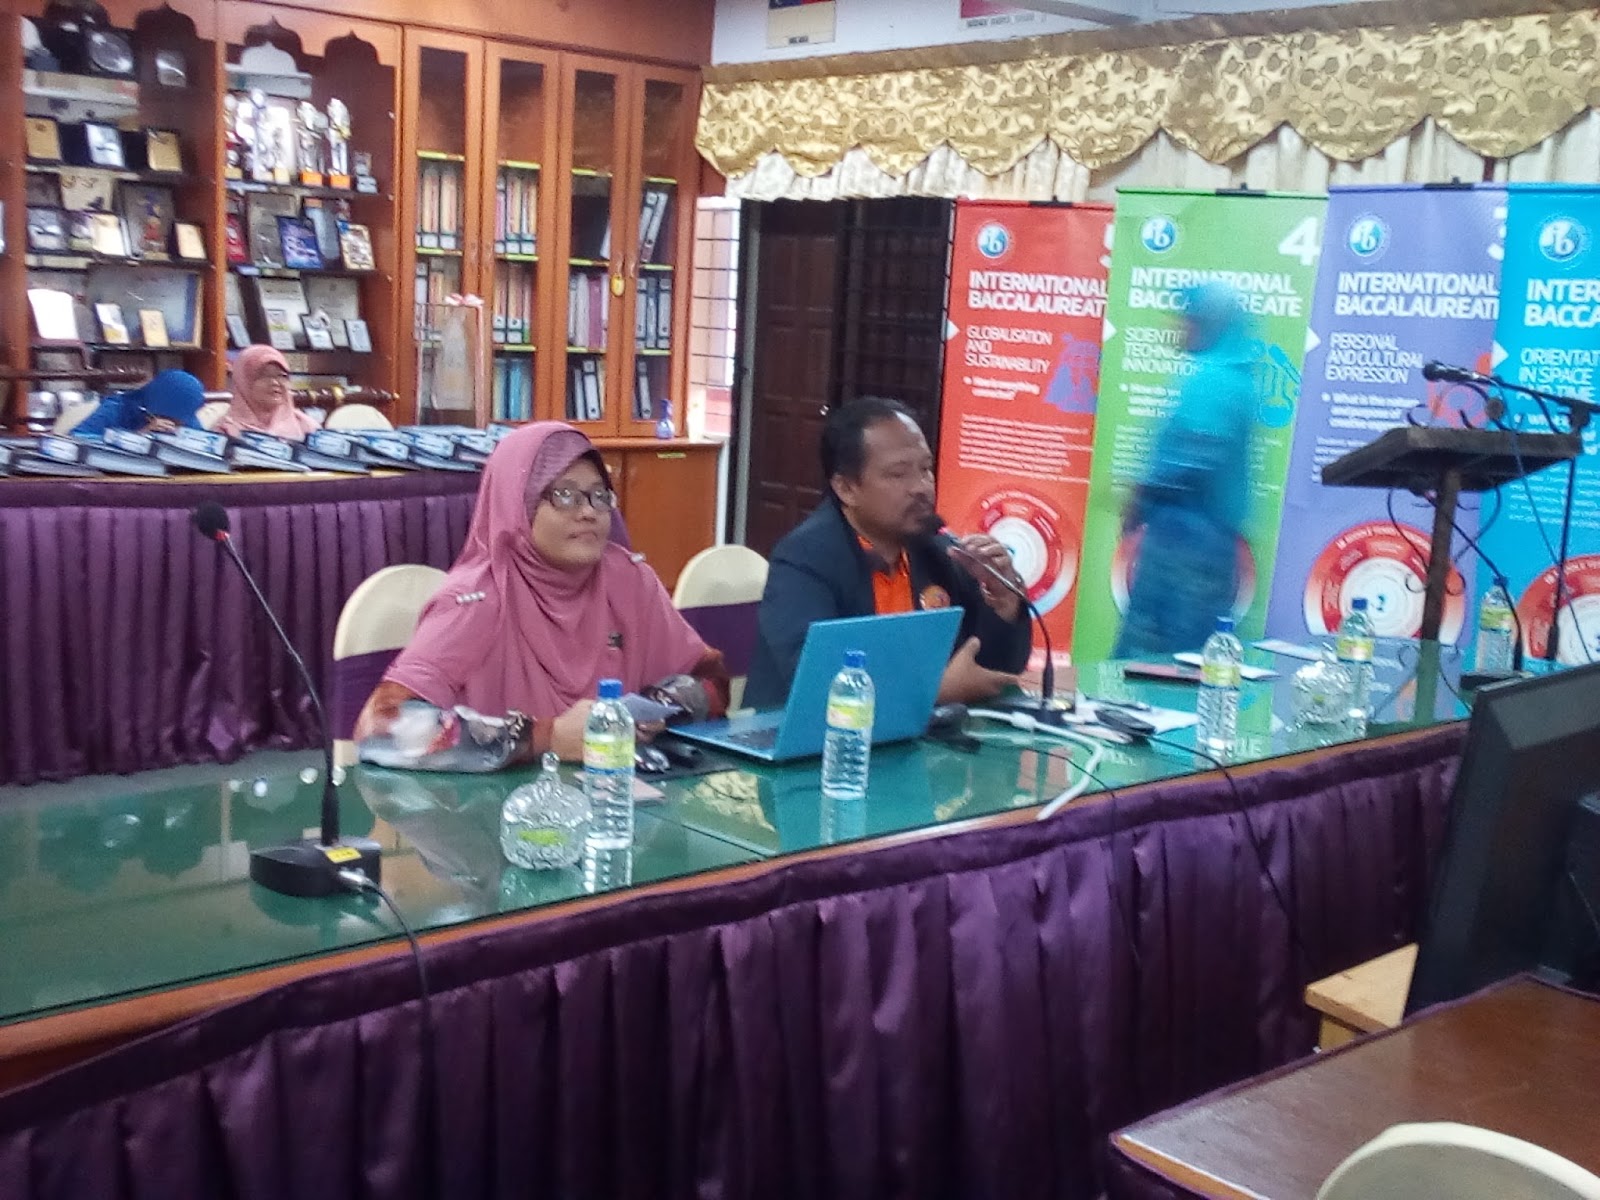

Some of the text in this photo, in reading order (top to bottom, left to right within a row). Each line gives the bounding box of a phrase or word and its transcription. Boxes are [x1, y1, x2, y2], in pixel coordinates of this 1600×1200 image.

[1278, 216, 1320, 266] 4
[969, 270, 1107, 297] INTERNATIONAL
[1337, 271, 1500, 295] INTERNATIONAL
[968, 289, 1107, 318] BACCALAUREAT
[965, 339, 992, 354] AND
[1330, 332, 1399, 351] PERSONAL
[1327, 349, 1356, 365] AND
[1325, 365, 1409, 384] EXPRESSION
[1518, 366, 1593, 386] IN SPACE
